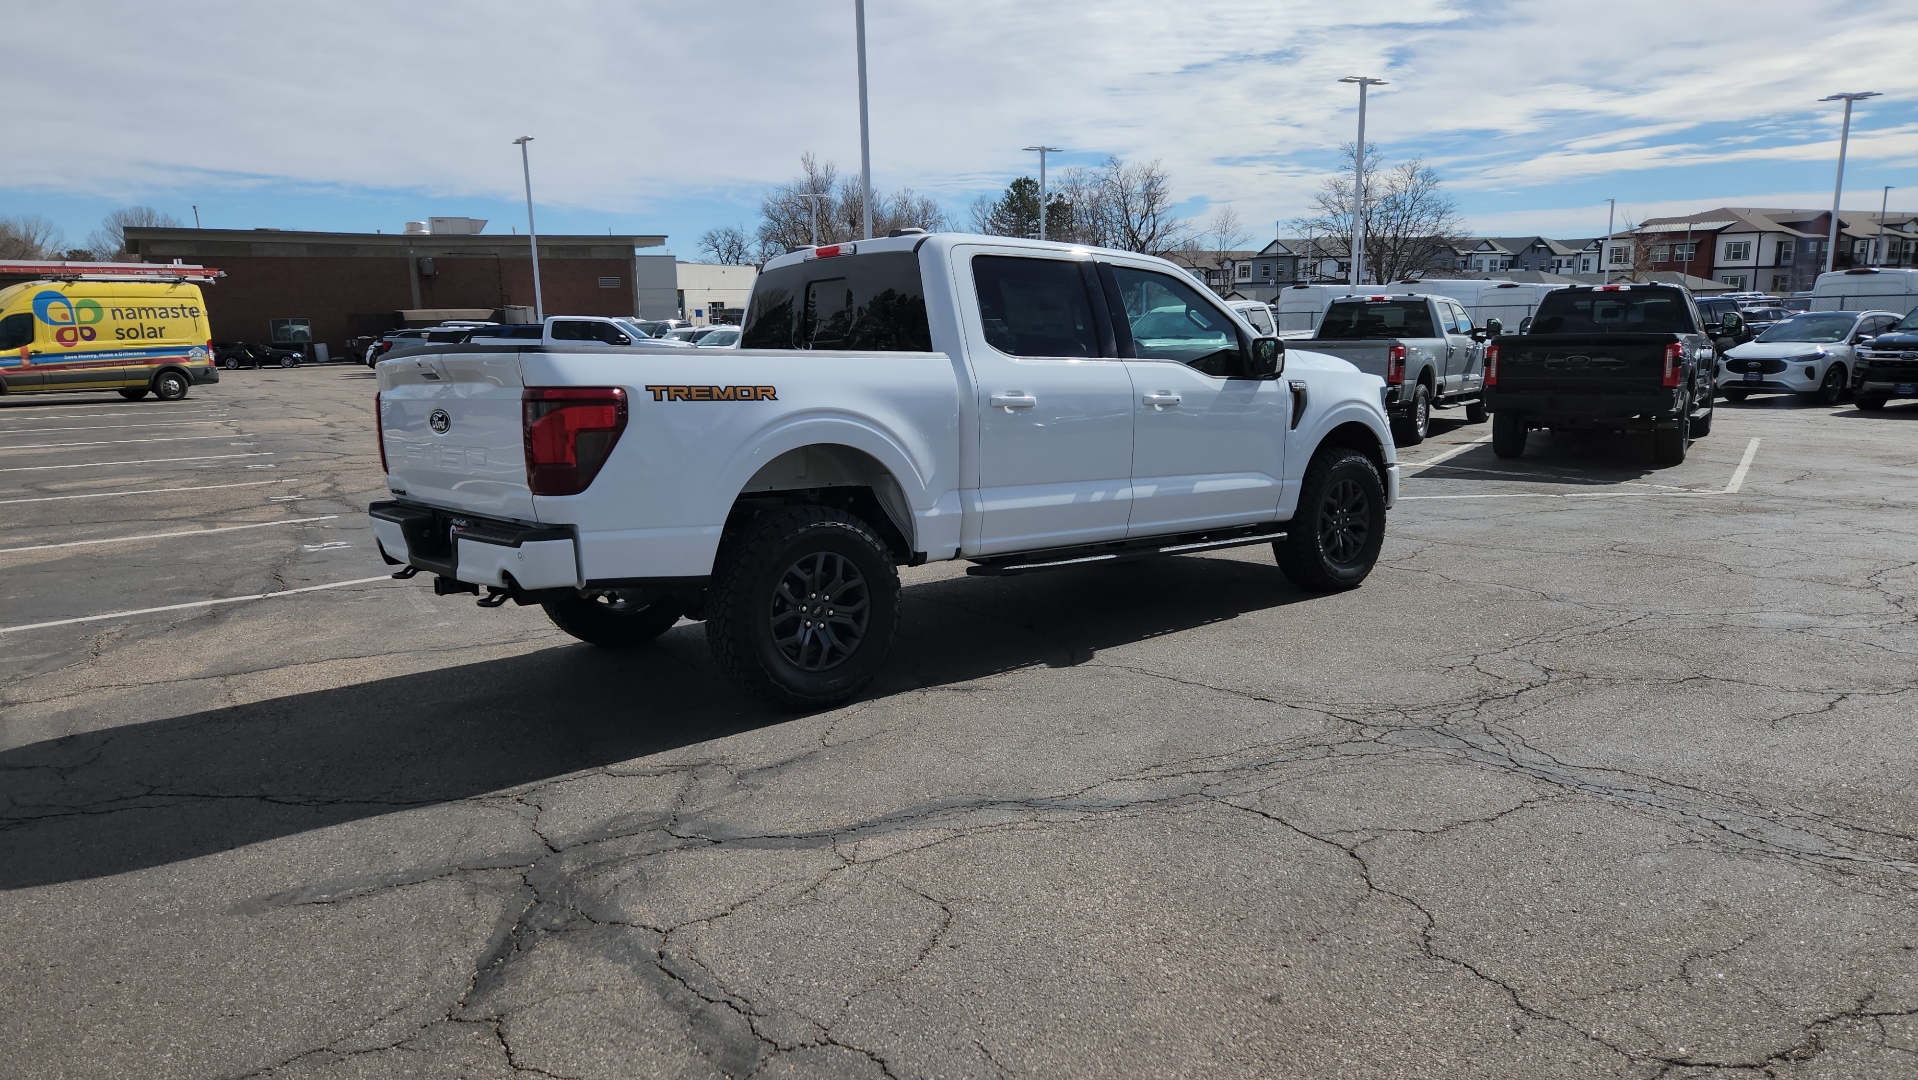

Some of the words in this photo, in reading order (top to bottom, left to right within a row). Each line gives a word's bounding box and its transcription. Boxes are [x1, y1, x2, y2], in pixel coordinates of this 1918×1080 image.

[111, 304, 200, 320] namaste
[115, 323, 165, 340] solar
[645, 385, 779, 401] TREMOR
